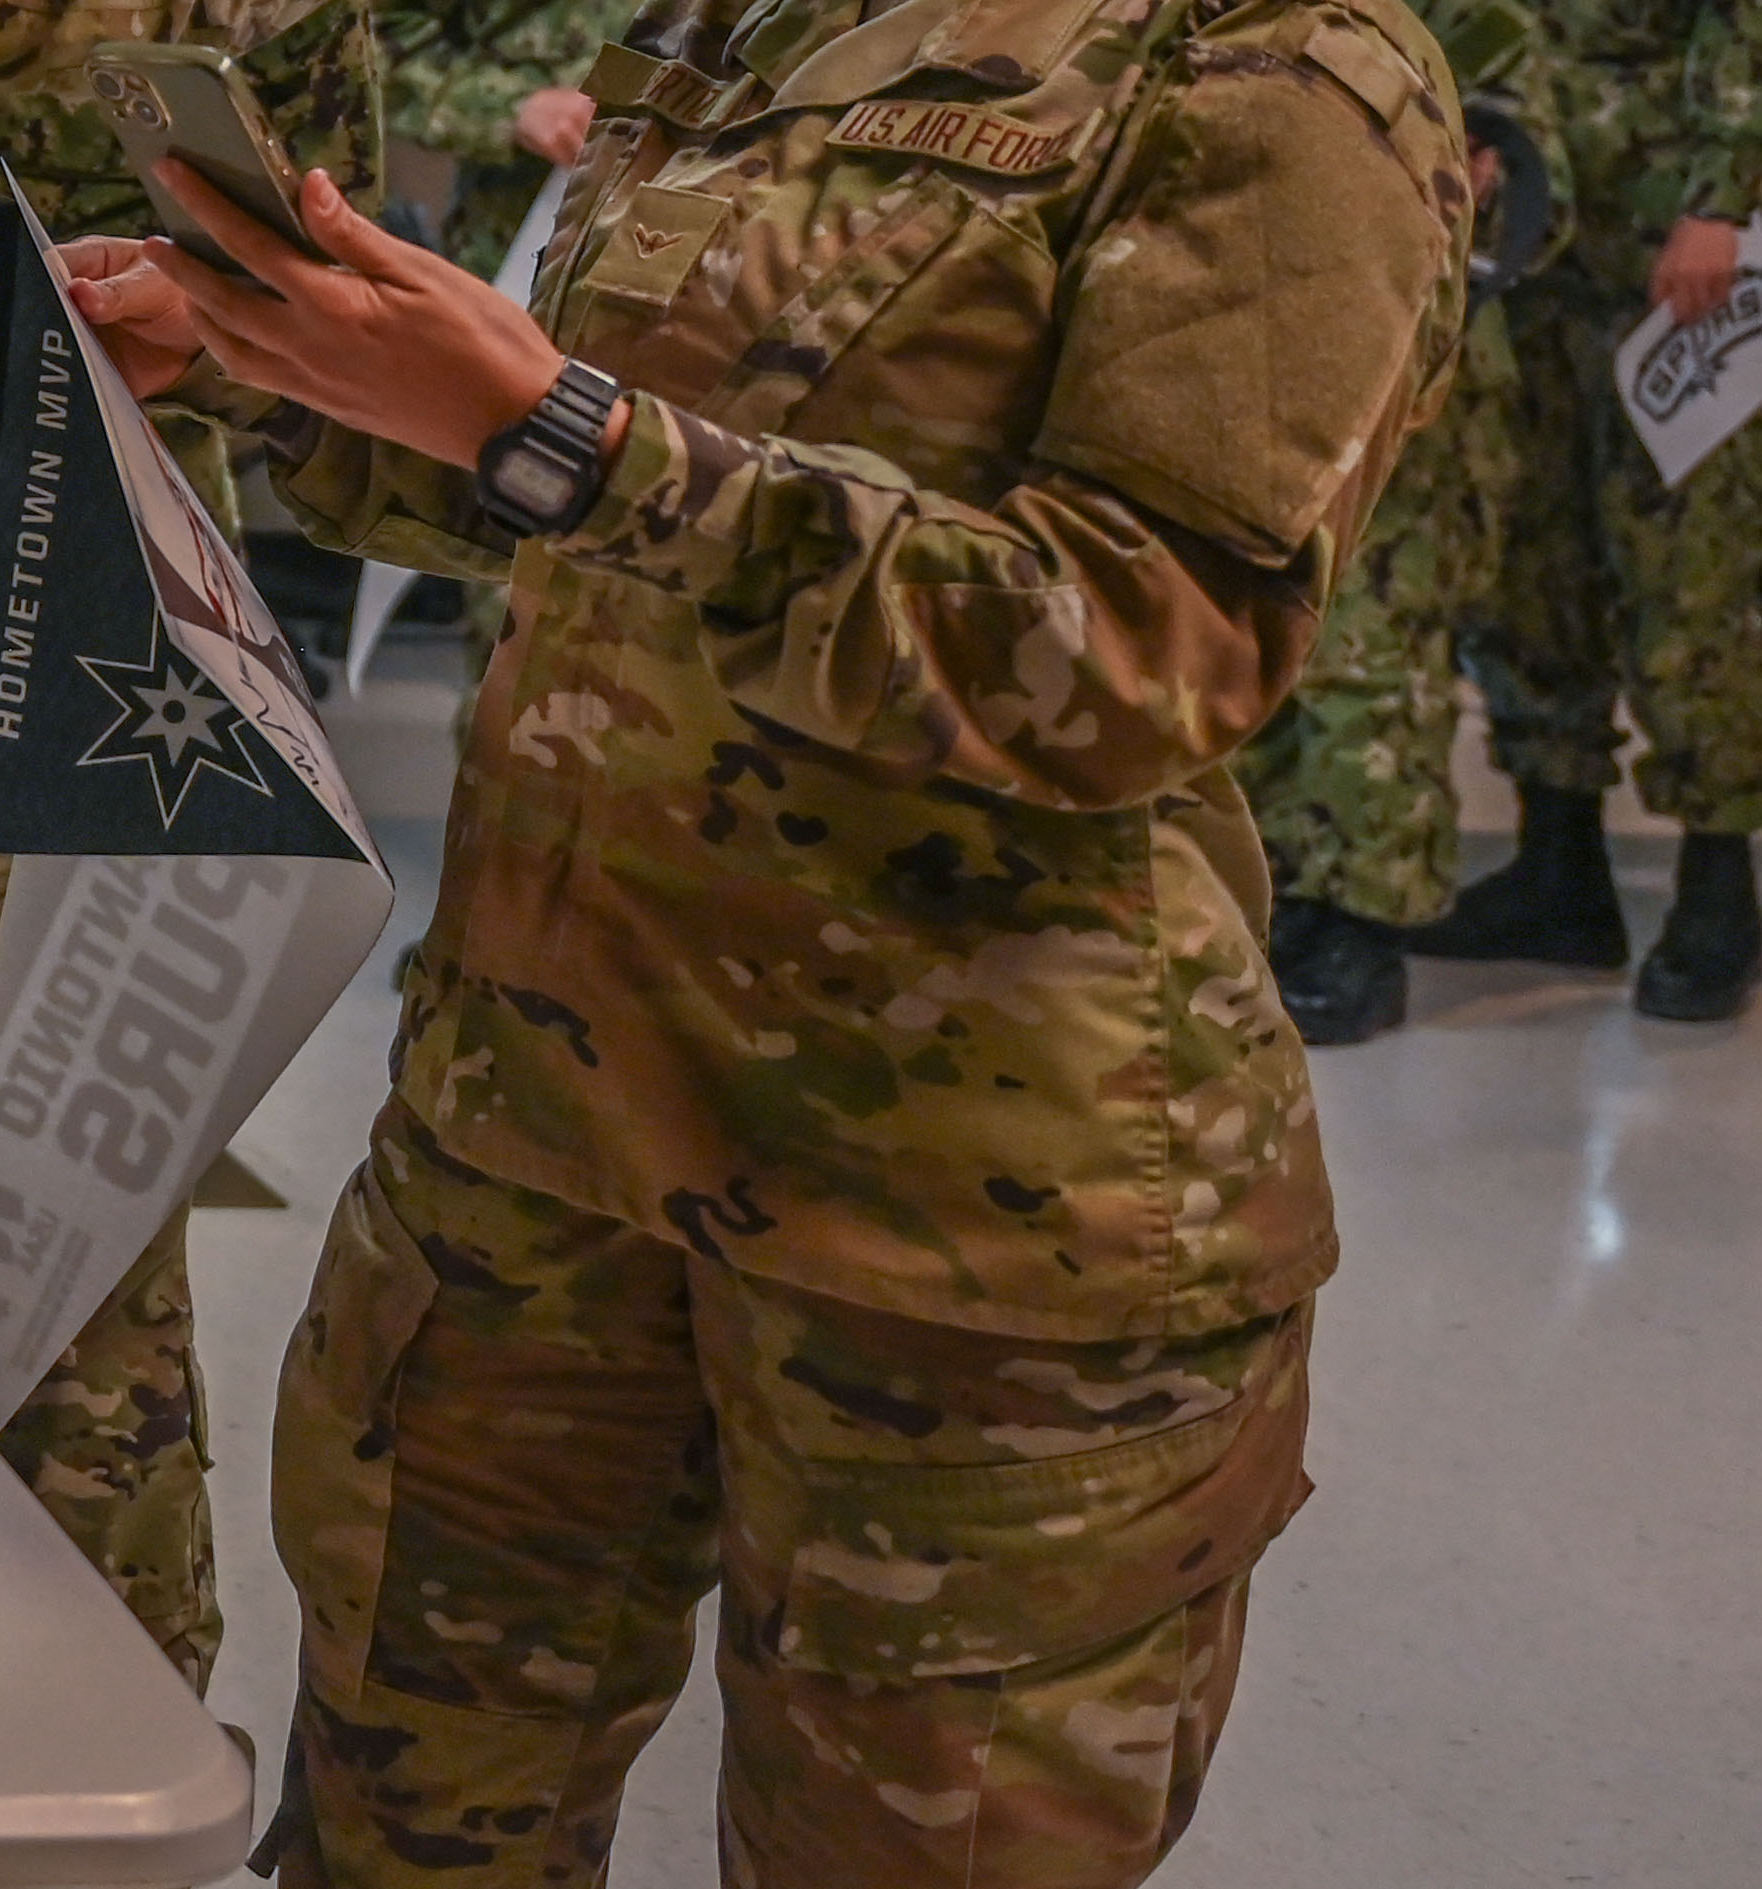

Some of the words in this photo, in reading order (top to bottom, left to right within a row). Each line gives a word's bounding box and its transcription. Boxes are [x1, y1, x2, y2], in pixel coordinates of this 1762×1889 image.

[840, 105, 906, 145] U.S.
[900, 108, 967, 154] AIR
[40, 328, 76, 431] MVP
